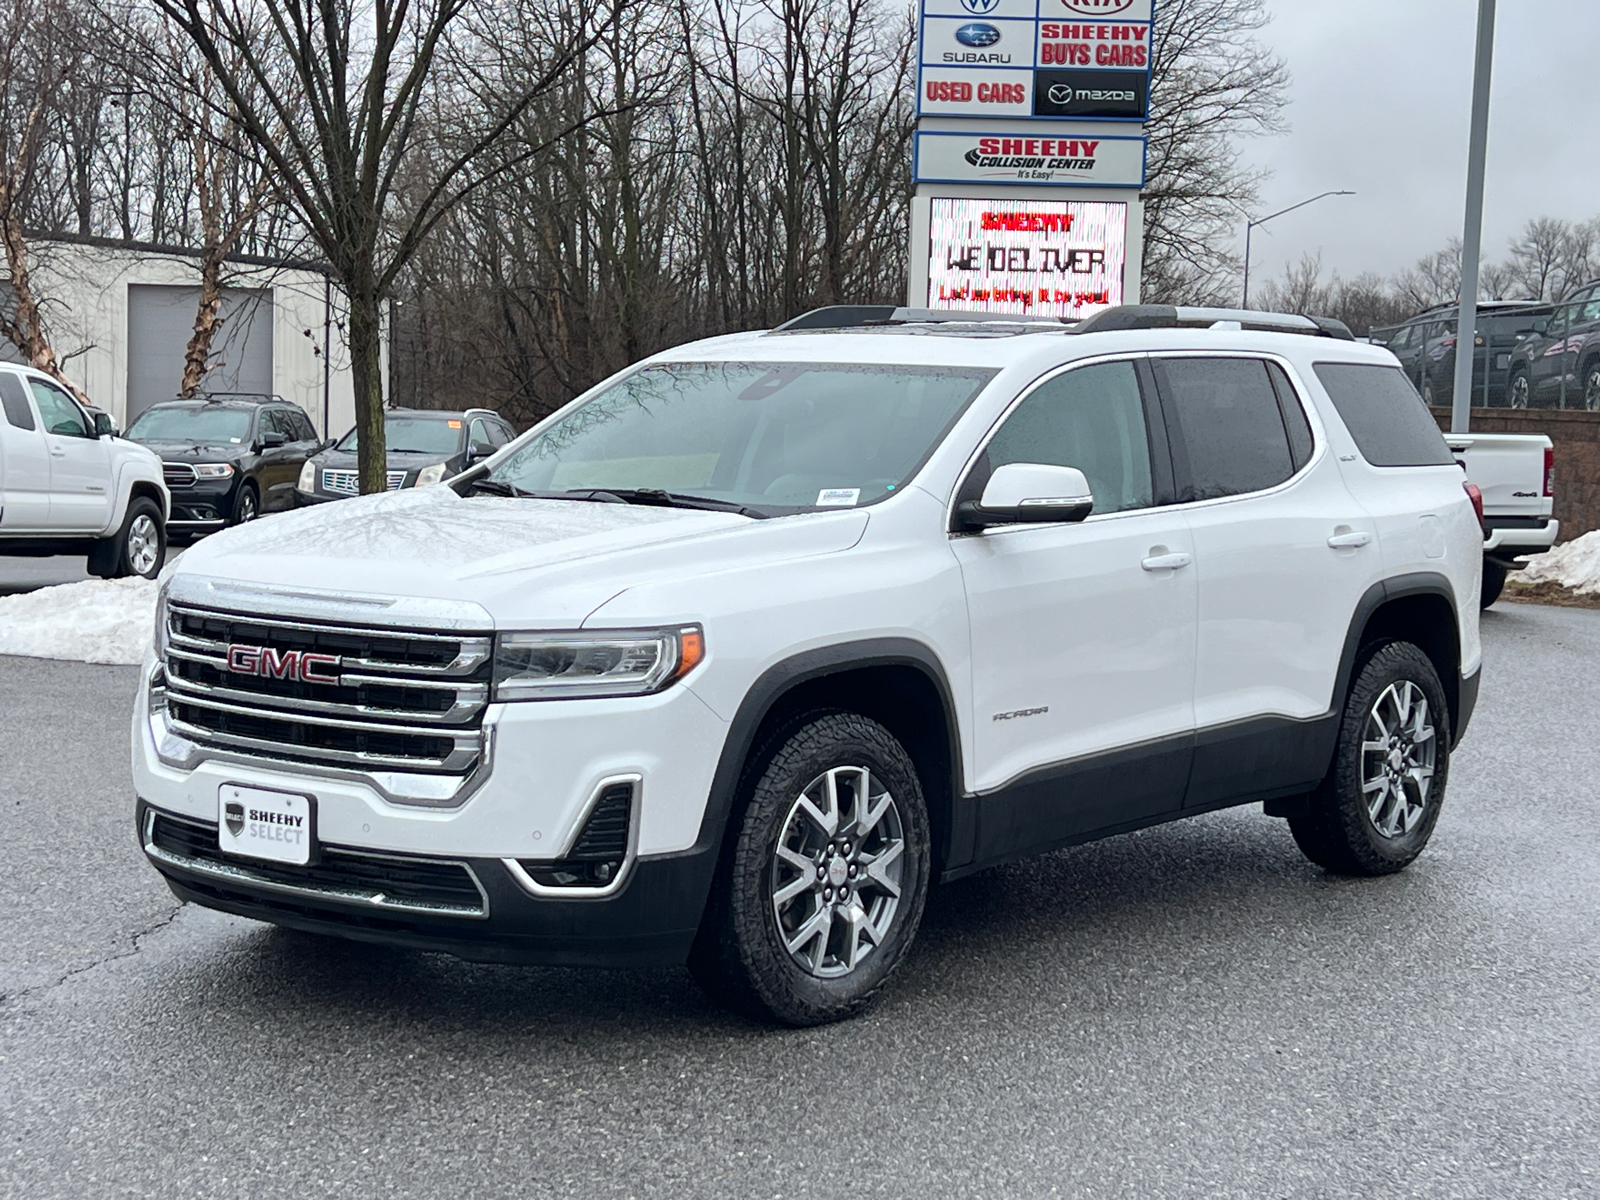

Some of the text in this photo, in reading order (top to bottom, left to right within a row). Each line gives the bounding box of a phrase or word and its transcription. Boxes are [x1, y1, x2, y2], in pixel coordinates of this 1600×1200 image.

[1041, 24, 1148, 41] SHEEHY
[942, 52, 1012, 64] SUBARU
[1041, 42, 1147, 67] BUYS CARS
[926, 80, 1025, 104] USED CARS
[979, 138, 1100, 157] SHEEHY
[979, 156, 1096, 170] COLLISION CENTER
[1017, 169, 1055, 180] It's Easy!
[947, 246, 1106, 274] WE DELIVER
[227, 643, 342, 687] GMC
[992, 705, 1049, 721] ACADIA
[249, 809, 304, 827] SHEEHY
[249, 822, 304, 845] SELECT
